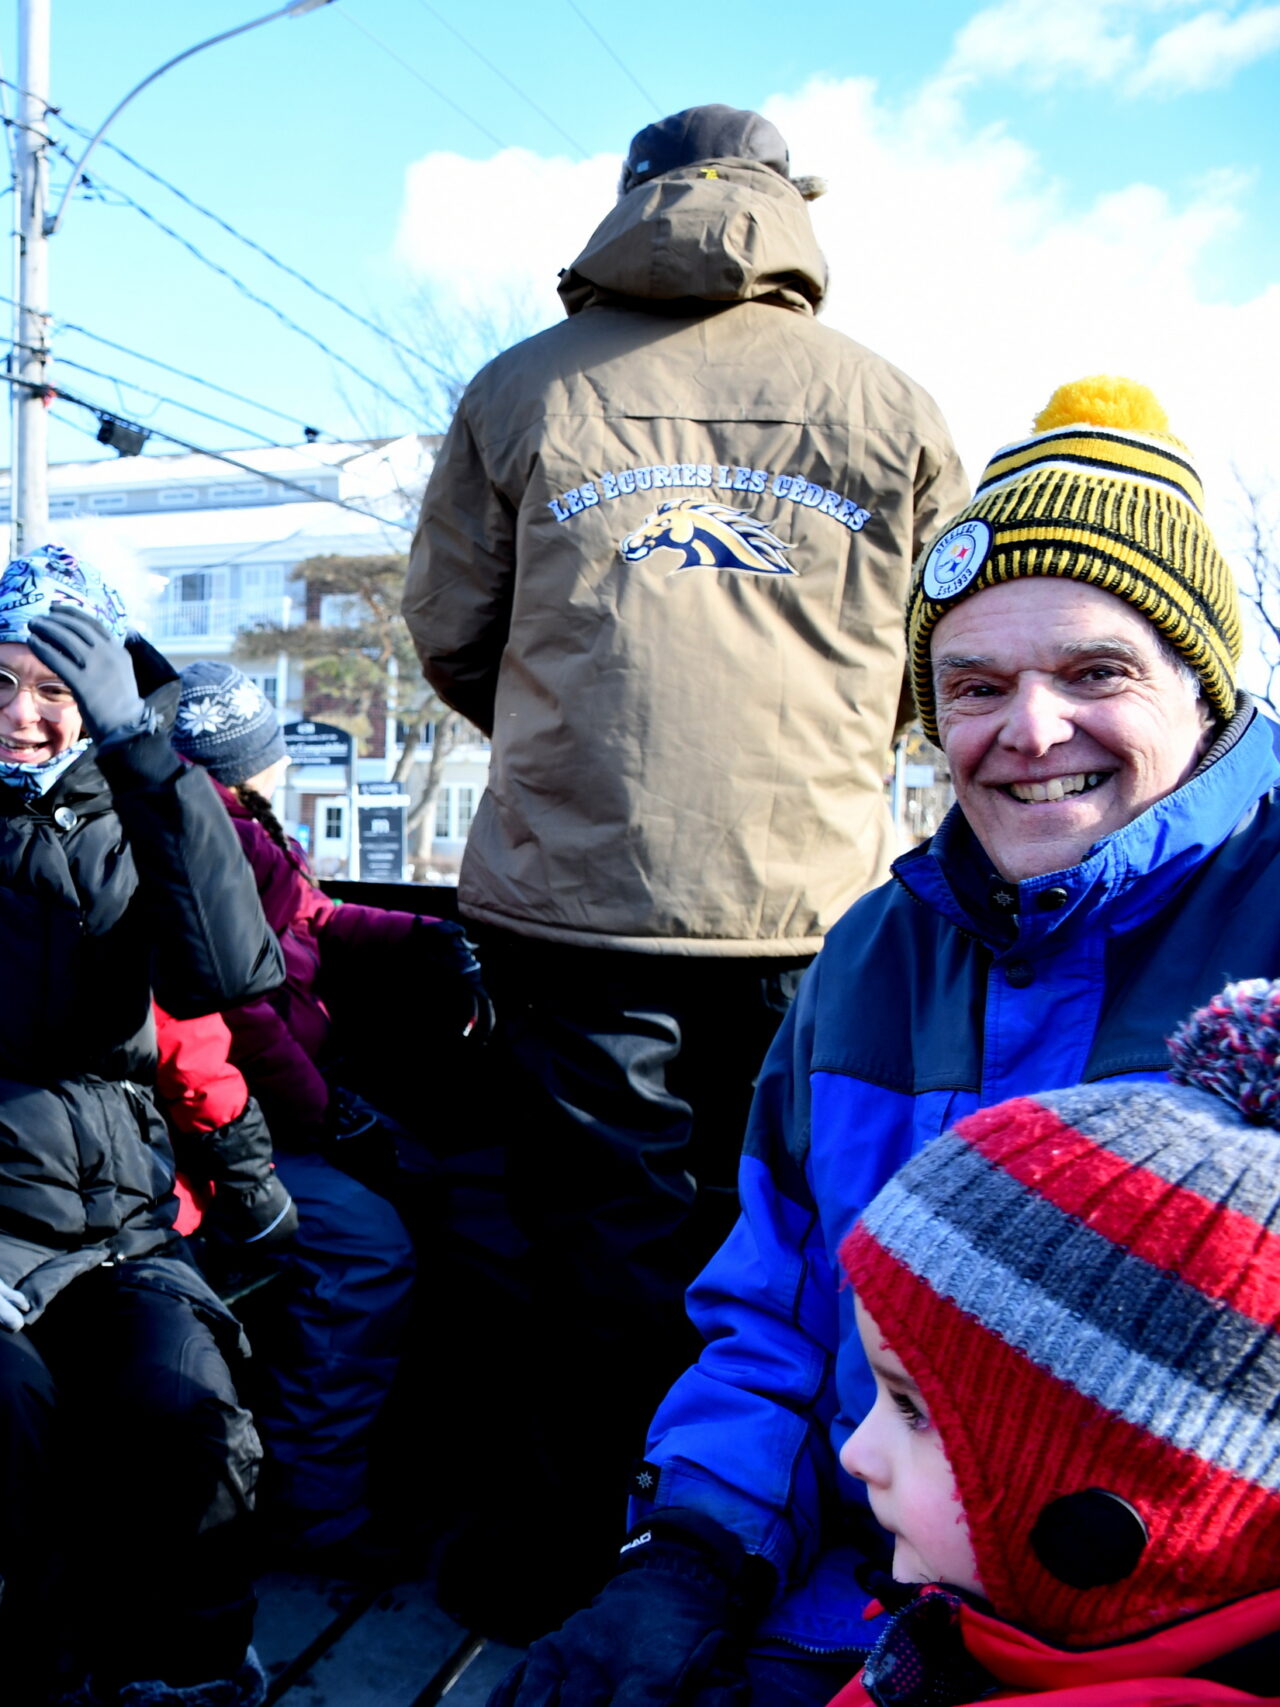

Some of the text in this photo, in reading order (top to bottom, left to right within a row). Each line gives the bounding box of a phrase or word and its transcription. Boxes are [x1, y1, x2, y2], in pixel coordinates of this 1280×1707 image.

[547, 482, 600, 522] LES
[600, 464, 713, 499] ÉCURIES
[718, 466, 769, 493] LES
